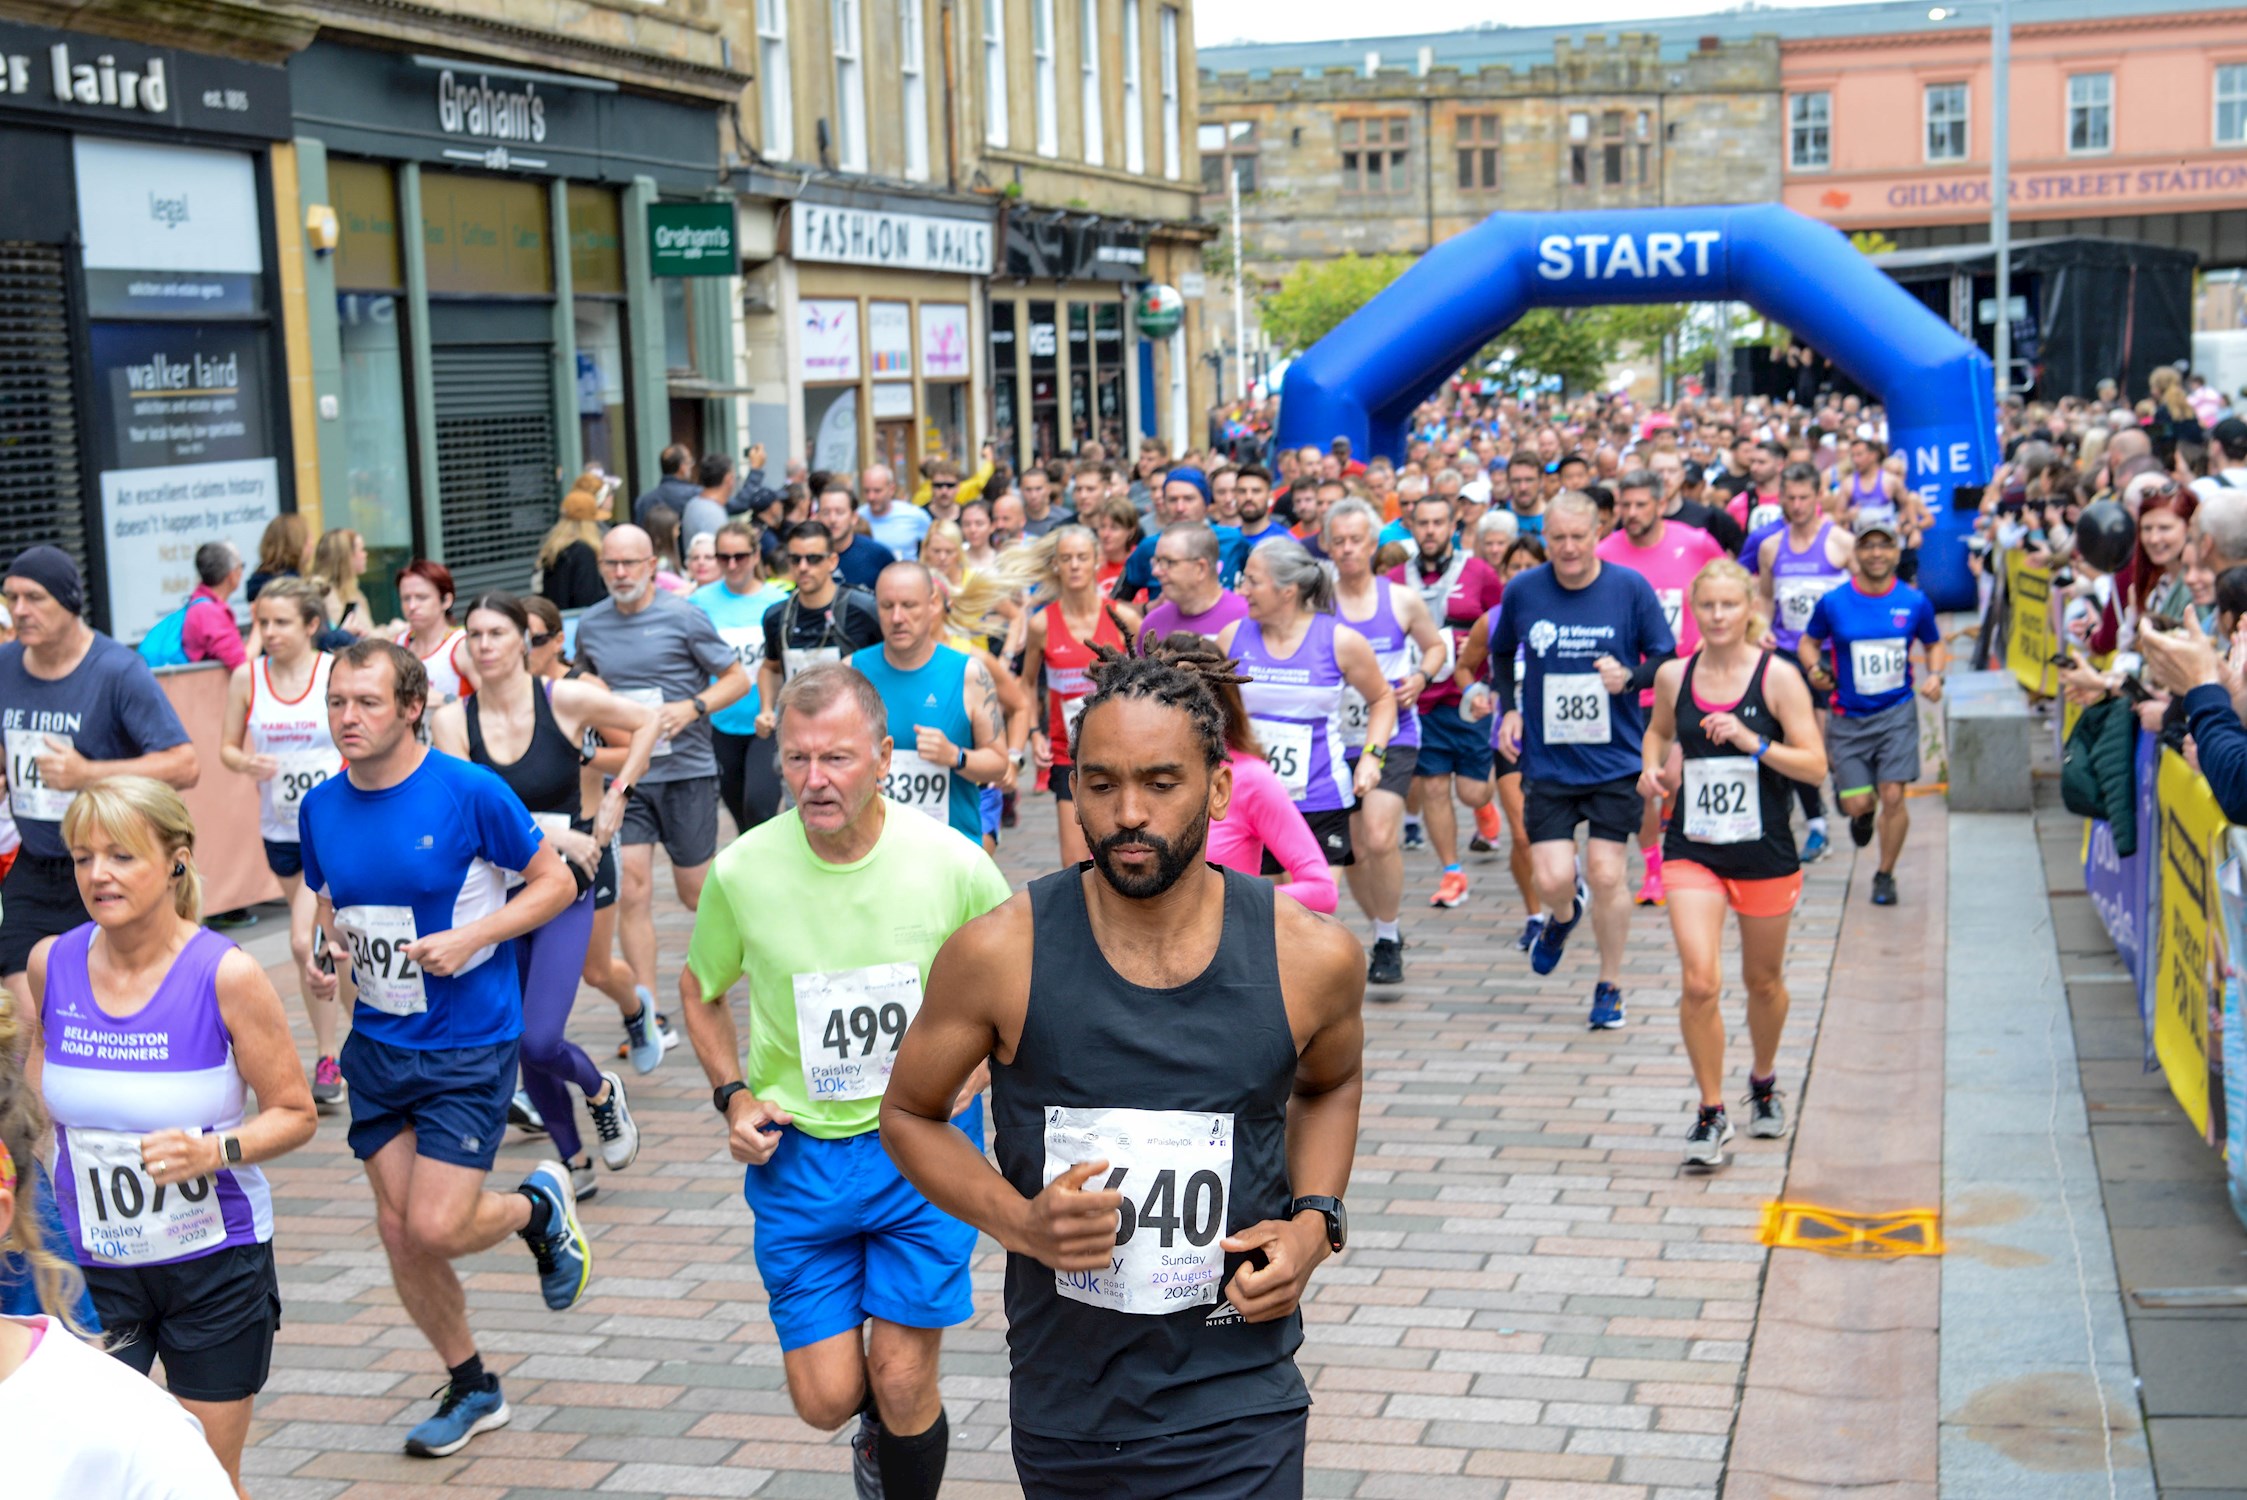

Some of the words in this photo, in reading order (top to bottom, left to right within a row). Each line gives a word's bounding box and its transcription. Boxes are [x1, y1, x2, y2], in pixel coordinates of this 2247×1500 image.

[51, 42, 167, 113] laird
[438, 70, 546, 143] Graham's
[2027, 173, 2131, 199] STREET
[148, 191, 190, 229] legal
[655, 225, 730, 248] Graham's
[806, 209, 909, 260] FASHION
[926, 223, 985, 268] NAILS
[1538, 231, 1720, 280] START
[126, 353, 190, 389] walker
[194, 352, 238, 387] laird
[117, 486, 132, 506] An
[136, 483, 189, 505] excellent
[192, 481, 225, 499] claims
[228, 477, 264, 497] history
[115, 515, 158, 538] doesn't
[161, 512, 202, 535] happen
[205, 509, 219, 530] by
[222, 505, 269, 526] accident.
[1789, 596, 1818, 614] 48
[1558, 625, 1569, 638] St
[1571, 625, 1615, 639] Vincent's
[1558, 638, 1597, 650] Hospice
[1248, 665, 1310, 677] BELLAHOUSTON
[1556, 694, 1600, 721] 383
[3, 708, 25, 729] BE
[30, 710, 82, 733] IRON
[261, 721, 317, 731] HAMILTON
[15, 754, 46, 788] 14
[1697, 782, 1747, 815] 482
[347, 931, 417, 980] 3492
[64, 1025, 168, 1046] BELLAHOUSTON
[822, 1002, 908, 1060] 499
[61, 1039, 94, 1057] ROAD
[97, 1046, 169, 1061] RUNNERS
[811, 1063, 862, 1078] Paisley
[814, 1076, 848, 1094] 10k
[1147, 1138, 1193, 1148] #Paisley10k
[169, 1206, 205, 1222] Sunday
[1072, 1165, 1224, 1248] 640
[90, 1223, 144, 1240] Paisley
[166, 1224, 180, 1236] 20
[181, 1215, 214, 1232] August
[179, 1228, 208, 1244] 2023
[92, 1241, 131, 1259] 10k
[1161, 1254, 1206, 1265] Sunday
[1104, 1279, 1125, 1289] Road
[1152, 1272, 1169, 1284] 20
[1172, 1269, 1213, 1285] August
[1104, 1288, 1124, 1298] Race
[1164, 1285, 1199, 1300] 2023
[1205, 1317, 1232, 1327] NIKE
